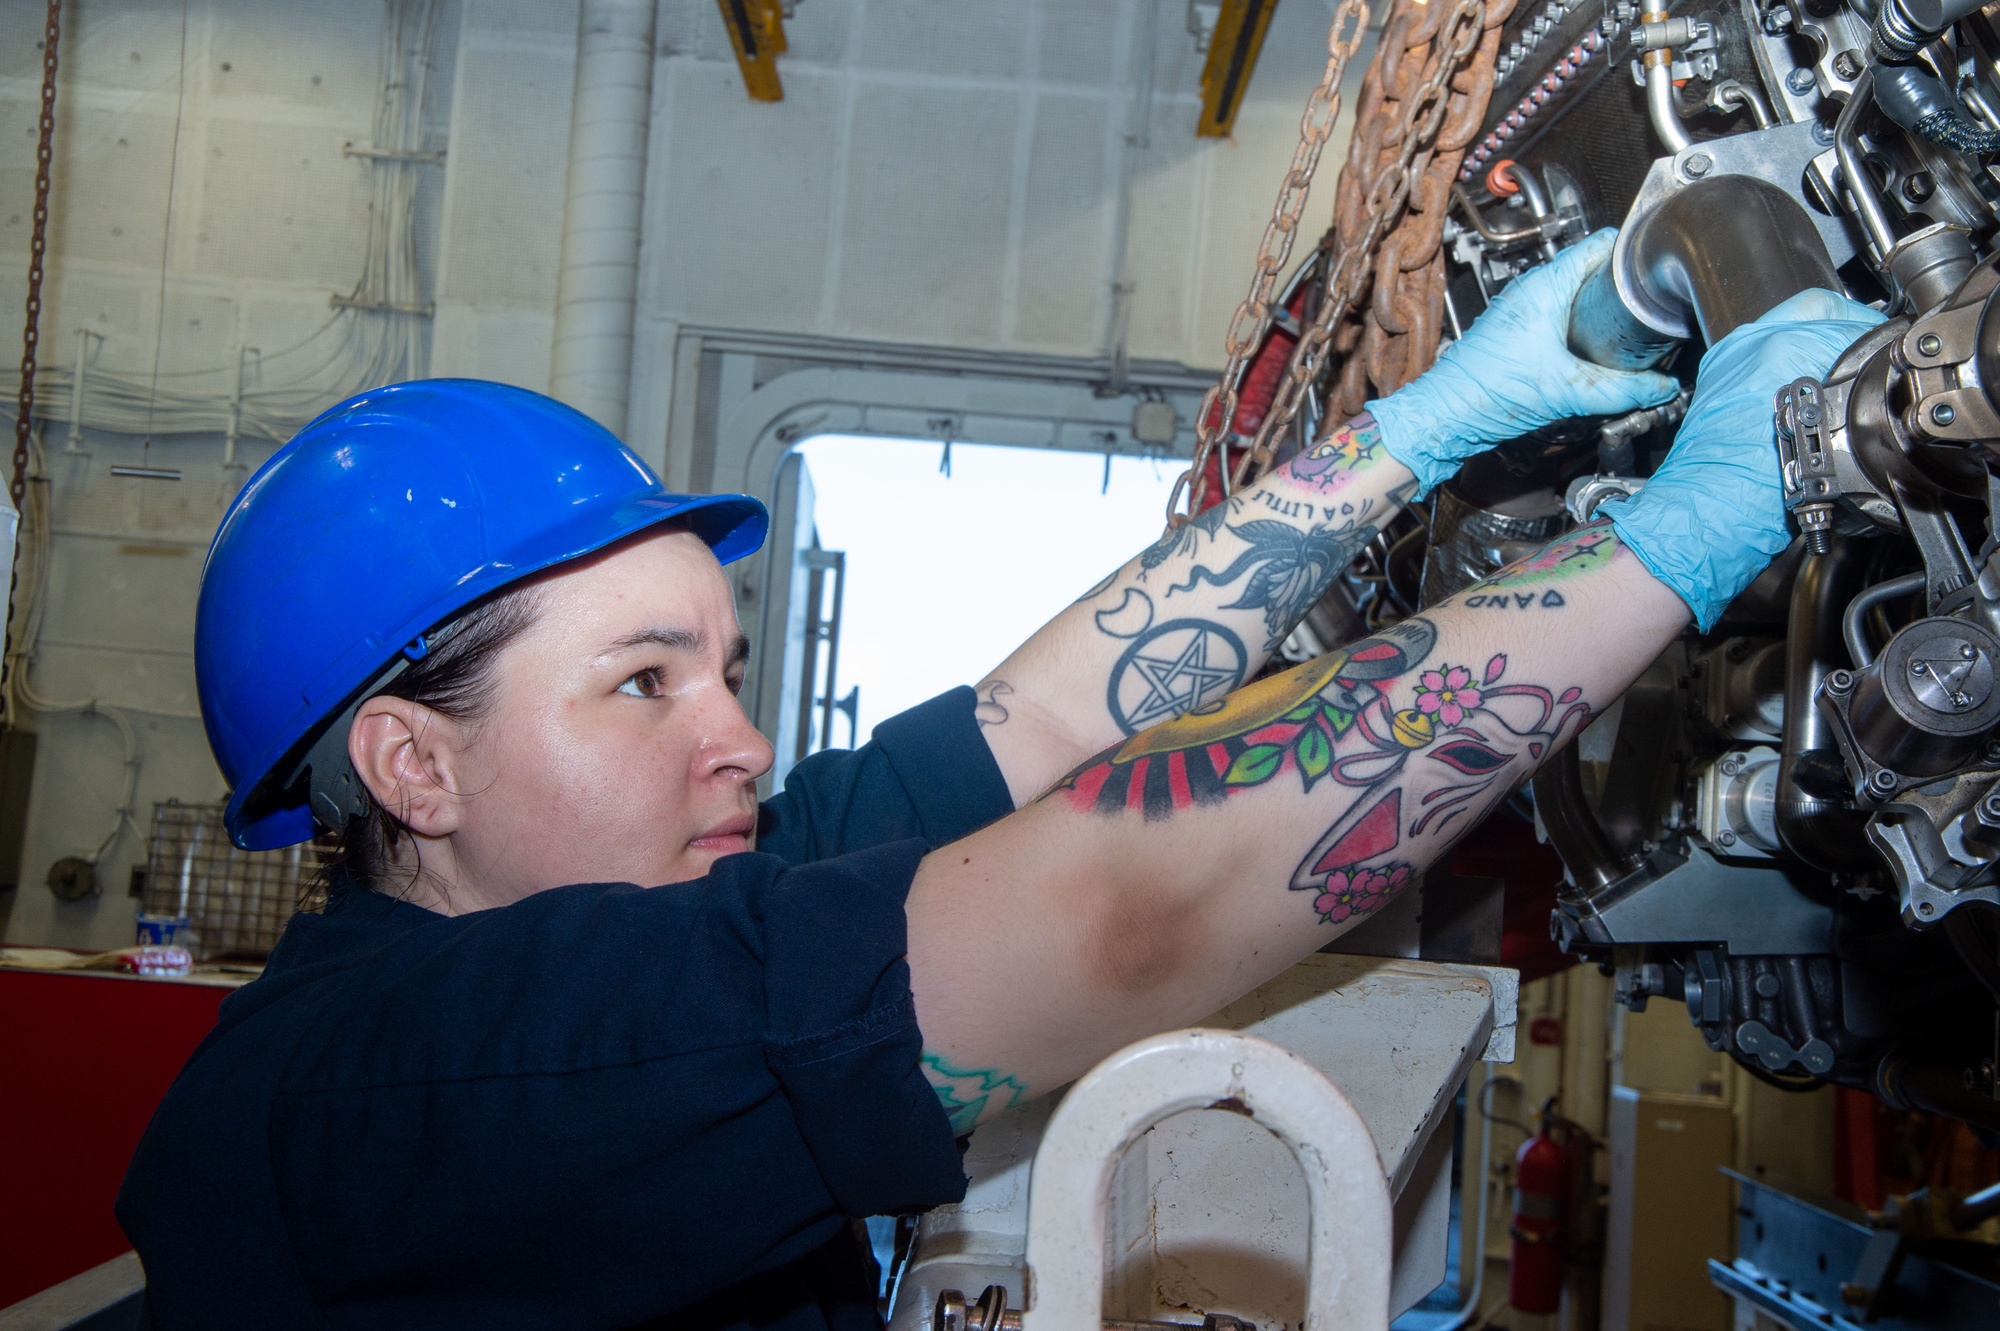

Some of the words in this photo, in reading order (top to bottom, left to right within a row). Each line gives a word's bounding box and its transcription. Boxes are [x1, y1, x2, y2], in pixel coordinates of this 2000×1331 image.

[1251, 489, 1314, 520] LITTLE
[1323, 506, 1336, 521] A
[1464, 592, 1535, 609] AND
